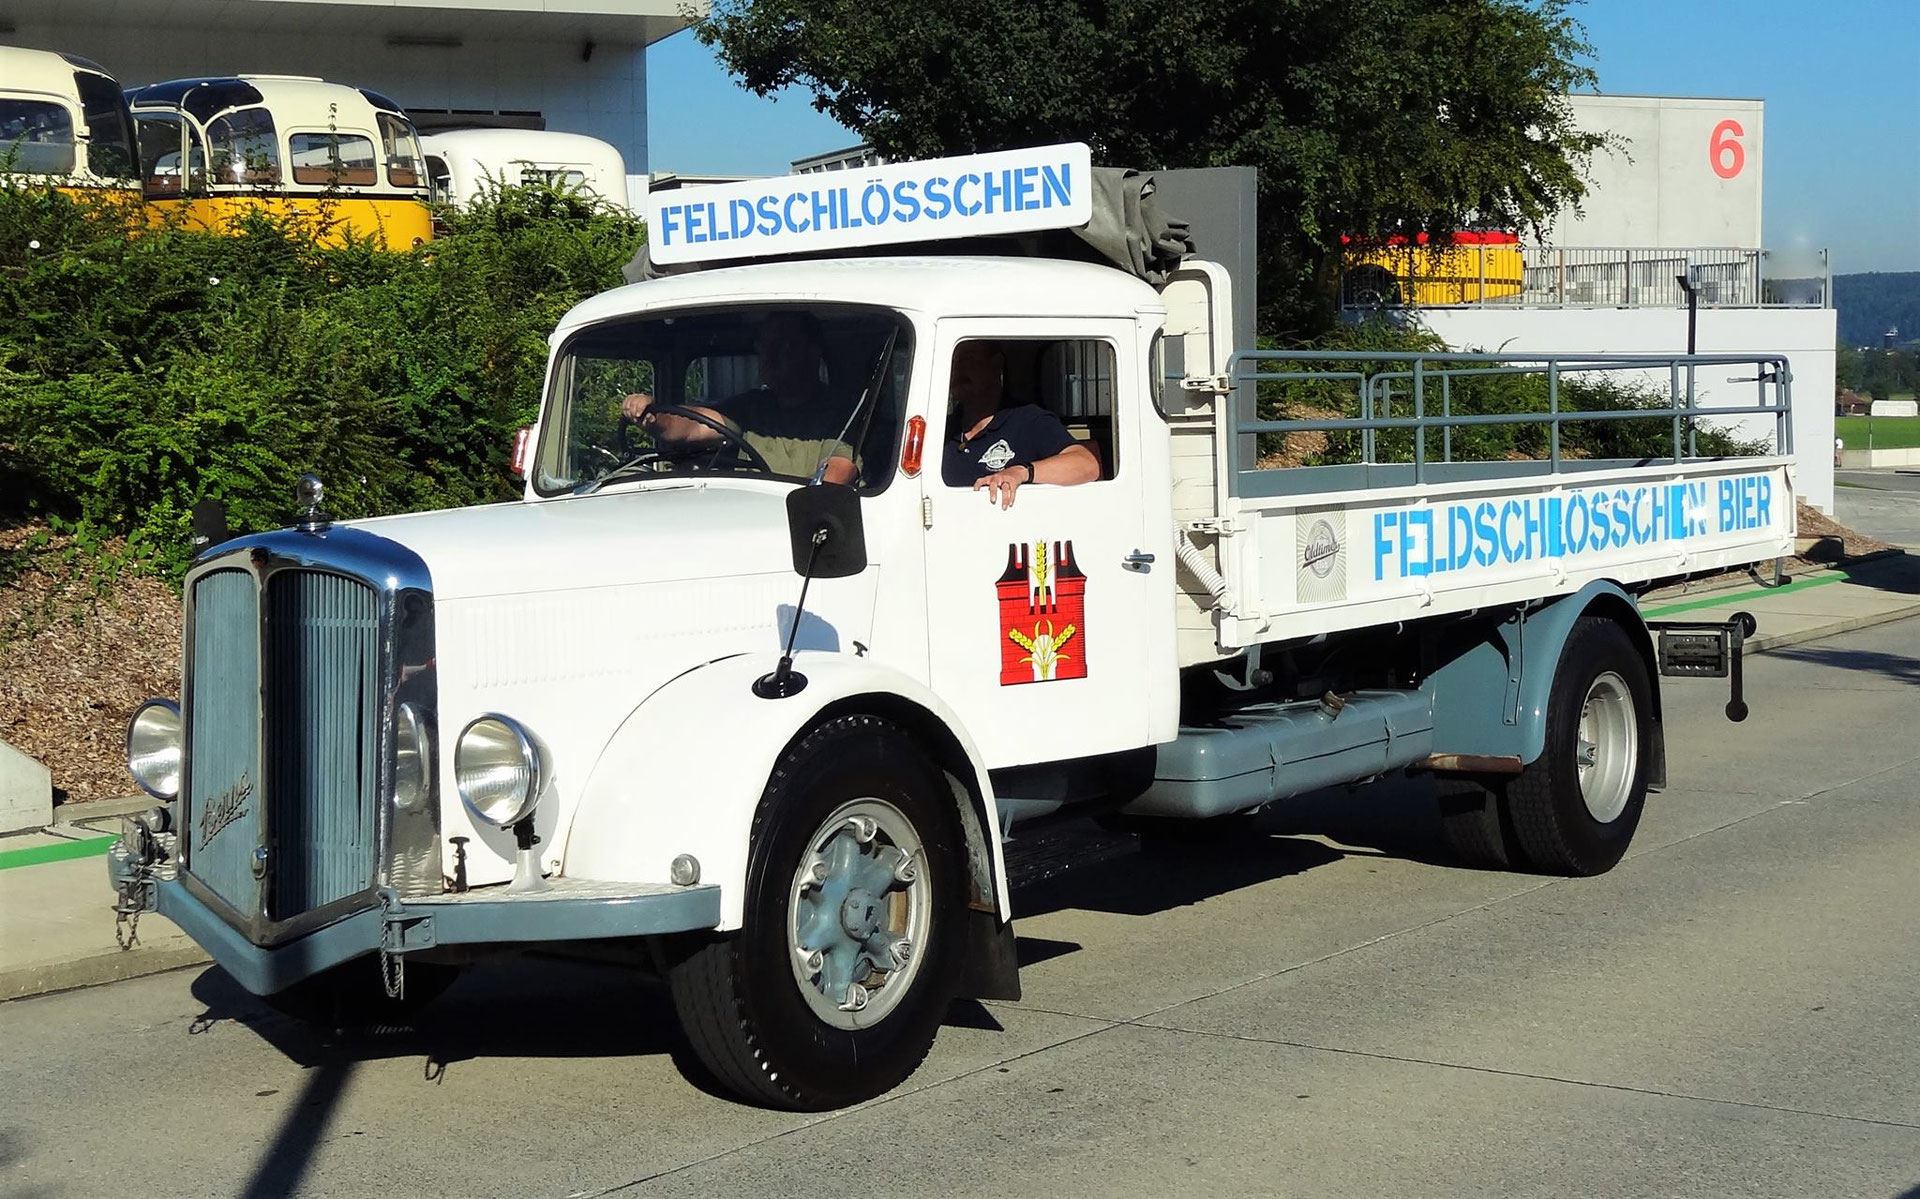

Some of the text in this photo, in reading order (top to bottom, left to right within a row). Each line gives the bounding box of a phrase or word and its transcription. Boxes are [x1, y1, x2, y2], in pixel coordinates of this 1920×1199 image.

[1709, 119, 1745, 179] 6
[661, 163, 1072, 246] FELDSCHLÖSSCHEN
[1718, 475, 1771, 533] BIER
